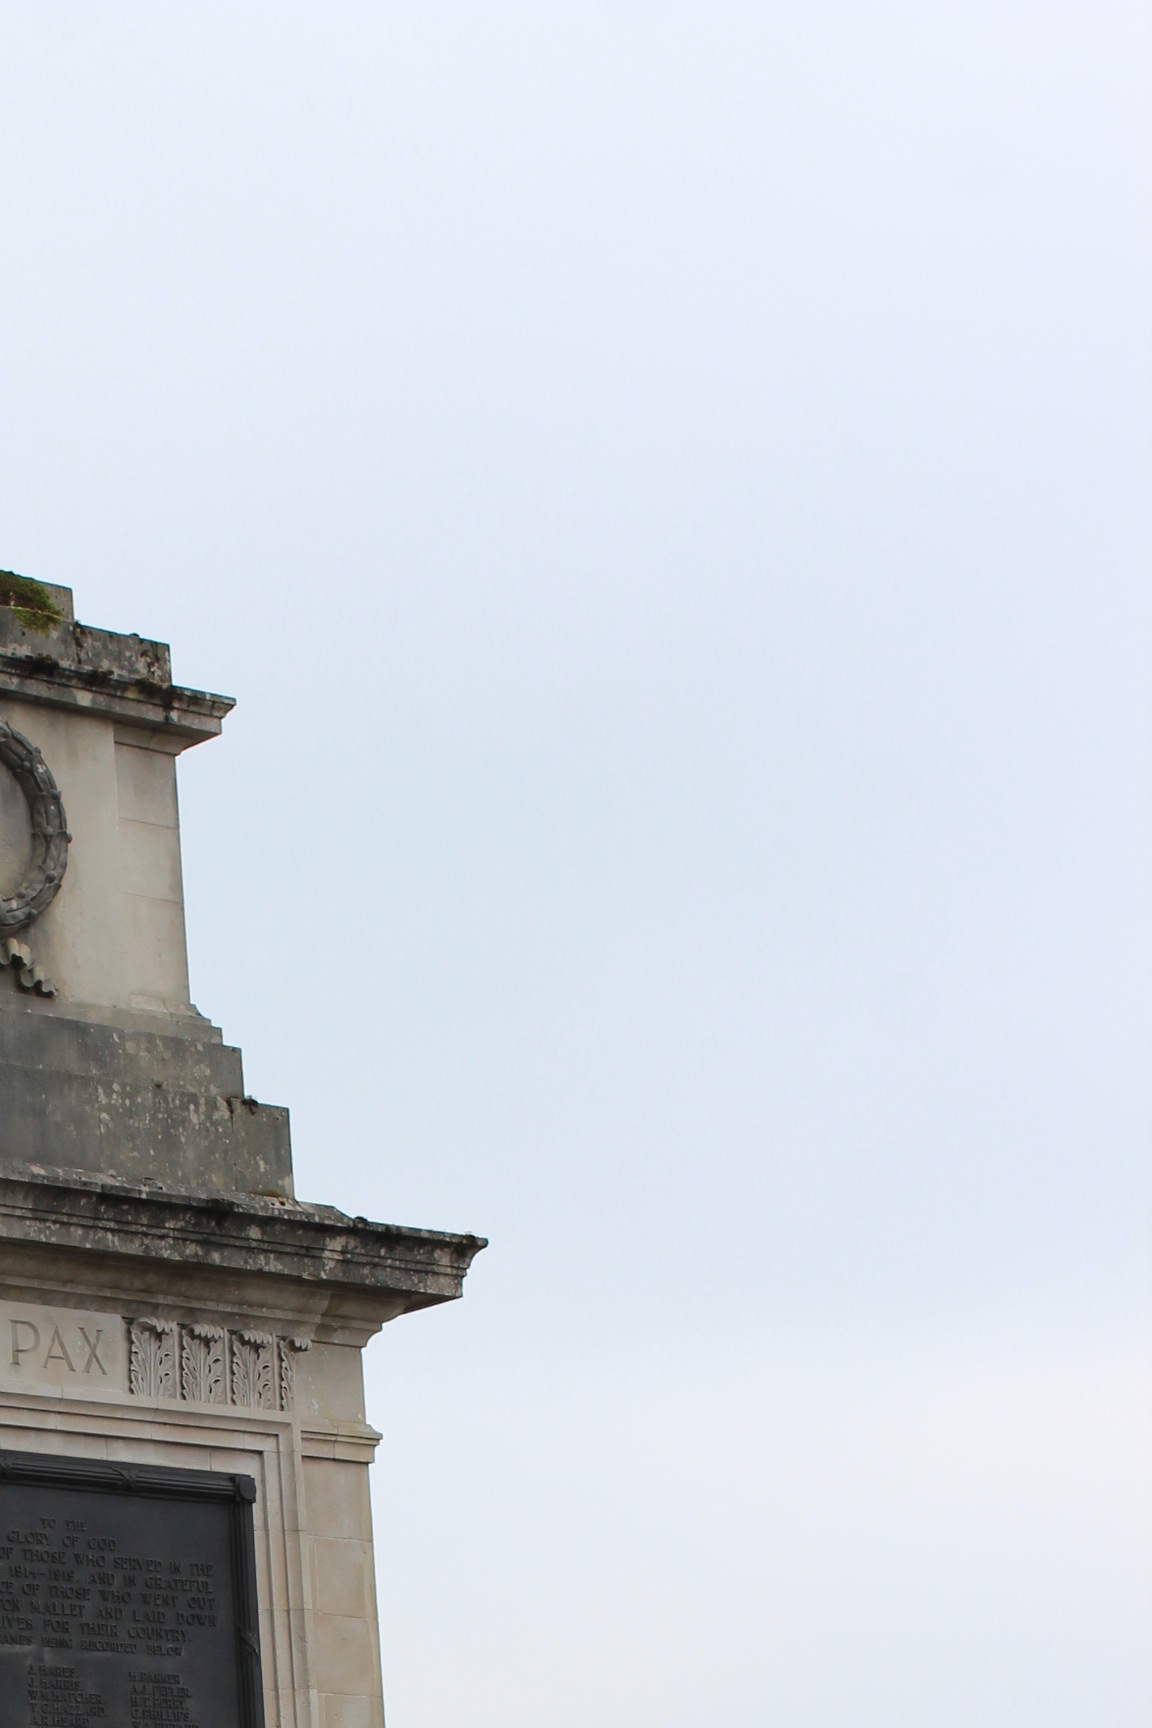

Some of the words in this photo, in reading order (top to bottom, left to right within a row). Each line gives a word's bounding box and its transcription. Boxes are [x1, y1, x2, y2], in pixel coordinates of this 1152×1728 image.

[8, 1318, 108, 1375] PAX
[39, 1517, 55, 1529] TO
[64, 1519, 87, 1532] THE
[7, 1528, 49, 1545] GLORY
[61, 1534, 79, 1548] OF
[22, 1547, 66, 1564] THOSE
[73, 1552, 105, 1568] WHO
[113, 1555, 162, 1573] SERVED
[168, 1561, 181, 1575] IN
[189, 1562, 214, 1578] THE
[88, 1570, 115, 1586] AND
[123, 1573, 136, 1587] IN
[144, 1575, 214, 1594] GRATEFUL
[22, 1581, 40, 1596] OF
[47, 1584, 90, 1601] THOSE
[98, 1588, 131, 1604] WHO
[140, 1592, 178, 1608] WENT
[186, 1596, 215, 1611] OUT
[29, 1599, 86, 1618] MALLET
[94, 1605, 123, 1621] AND
[132, 1608, 166, 1624] LAID
[175, 1611, 216, 1628] DOWN
[42, 1618, 70, 1633] FOR
[79, 1621, 118, 1637] THEIR
[41, 1635, 73, 1649] BEING
[80, 1639, 137, 1654] RECORDED
